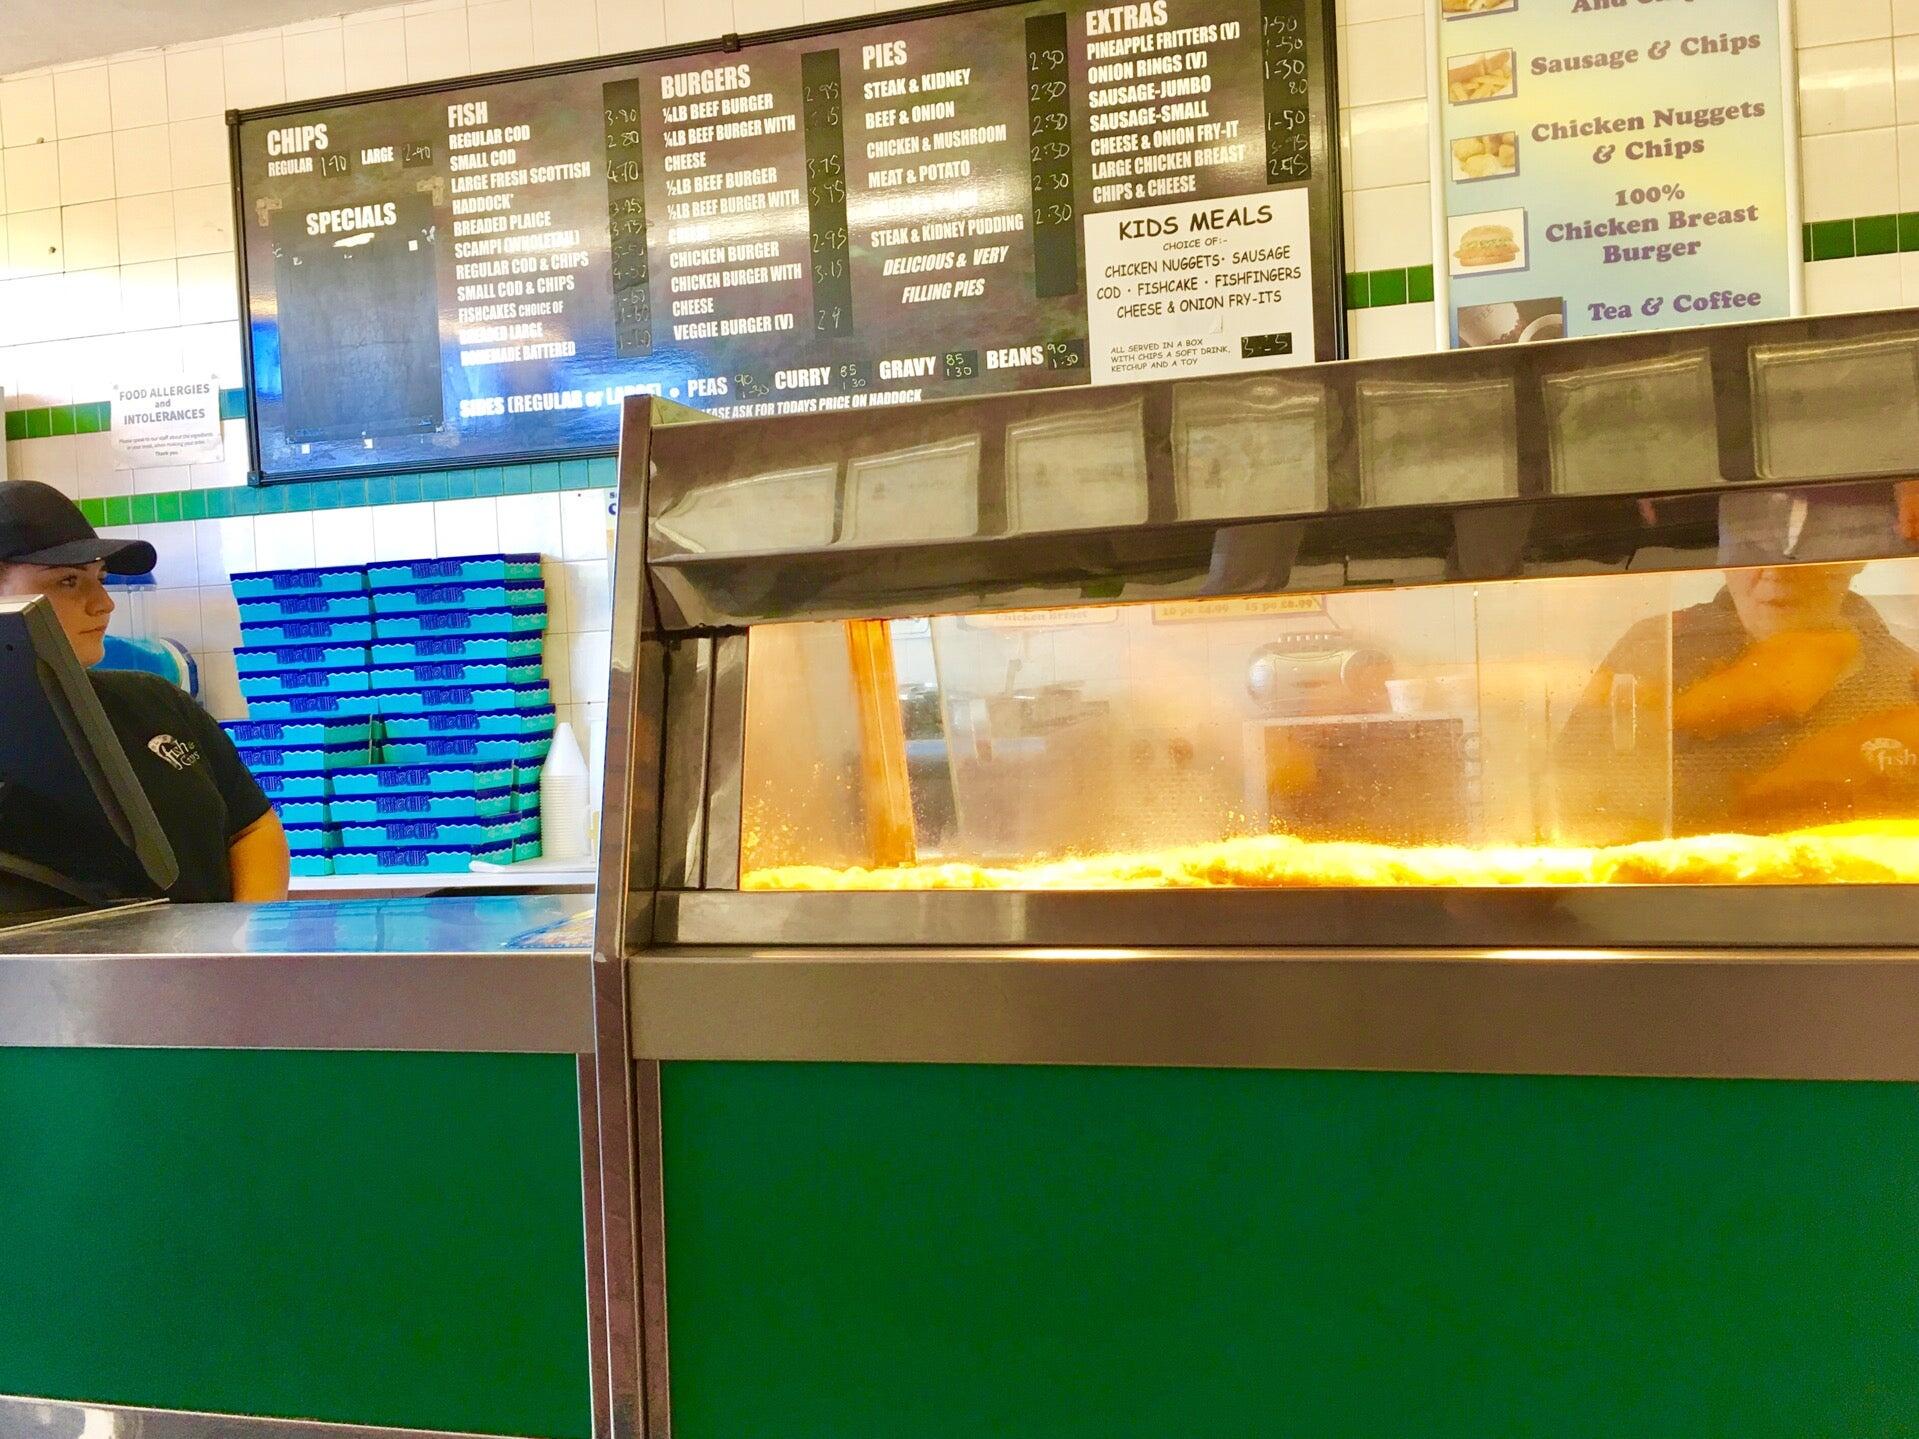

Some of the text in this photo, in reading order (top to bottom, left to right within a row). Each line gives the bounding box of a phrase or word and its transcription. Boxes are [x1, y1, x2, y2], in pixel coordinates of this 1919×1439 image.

[1086, 0, 1168, 36] EXTRAS
[1087, 21, 1240, 60] PINEAPPLE FRITTERS (V)
[1530, 33, 1761, 76] Sausage & Chips
[862, 40, 907, 70] PIES
[1088, 51, 1208, 85] ONION RINGS (V)
[661, 64, 750, 99] BURGERS
[863, 68, 971, 100] STEAK KIDNEY
[1088, 74, 1212, 108] SAUSAGE-JUMBO
[448, 101, 488, 128] FISH
[690, 101, 720, 120] BEEF
[722, 93, 774, 116] BURGER
[865, 101, 955, 130] BEEF ONION
[1089, 100, 1209, 132] SAUSAGE-SMALL
[688, 125, 716, 145] BEEF
[716, 119, 762, 141] BURGER
[764, 114, 796, 134] WITH
[1531, 101, 1766, 142] Chicken Nuggets
[267, 123, 328, 156] CHIPS
[449, 124, 531, 150] REGULAR COD
[866, 124, 1007, 159] CHICKEN MUSHROOM
[1091, 120, 1239, 156] CHEESE ONION FRY-IT
[1592, 137, 1705, 164] & Chips
[268, 157, 314, 177] REGULAR
[361, 146, 394, 165] LARGE
[450, 149, 516, 172] SMALL COD
[664, 152, 706, 172] CHEESE
[1092, 144, 1246, 180] LARGE CHICKEN BREAST
[451, 161, 591, 193] LARGE FRESH SCOTTISH
[694, 174, 723, 193] BEEF
[726, 167, 777, 189] BURGER
[868, 159, 970, 189] MEAT POTATO
[692, 199, 719, 216] BEEF
[720, 194, 766, 214] BURGER
[768, 189, 800, 207] WITH
[1093, 174, 1196, 204] CHIPS CHEESE
[1615, 183, 1685, 207] 100%
[306, 202, 397, 235] SPECIALS
[453, 211, 551, 237] BREADED PLAICE
[871, 213, 1024, 248] STEAK KIDNEY PUDDING
[1119, 205, 1273, 240] KIDS MEALS
[1545, 205, 1759, 243] Chicken Breast
[455, 239, 502, 259] SCAMPI
[670, 247, 725, 269] CHICKEN
[728, 241, 780, 262] BURGER
[1162, 239, 1201, 251] CHOICE
[1602, 239, 1702, 264] Burger
[456, 251, 589, 280] REGULAR COD CHIPS
[883, 246, 1010, 277] DELICIOUS VERY
[1105, 261, 1158, 279] CHICKEN
[1232, 245, 1291, 264] SAUSAGE
[457, 275, 575, 302] SMALL COD CHIPS
[671, 263, 802, 293] CHICKEN BURGER WITH
[901, 278, 985, 304] FILLING PIES
[1097, 266, 1301, 300] COD FISHCAKE FISHFINGERS
[458, 301, 564, 323] FISHCAKES CHOICE OF
[672, 298, 714, 317] CHEESE
[1117, 290, 1282, 319] CHEESE ONION FRY-ITS
[1587, 290, 1761, 321] Tea & Coffee
[673, 313, 794, 341] VEGGIE BURGER (V)
[986, 345, 1044, 370] BEANS
[1110, 338, 1203, 354] ALL SERVED IN BOX
[1111, 354, 1135, 363] WITH
[1138, 352, 1163, 361] CHIPS
[1175, 348, 1197, 357] SOFT
[774, 367, 831, 390] CURRY
[879, 356, 936, 380] GRAVY
[1111, 358, 1198, 373] KETCHUP AND TOY
[120, 384, 210, 401] FOOD ALLERGIES
[687, 377, 728, 398] PEAS
[124, 408, 206, 425] INTOLERANCES
[155, 399, 171, 408] and
[732, 388, 922, 418] ASK FOR TODAYS PRICE ON HADDOCK
